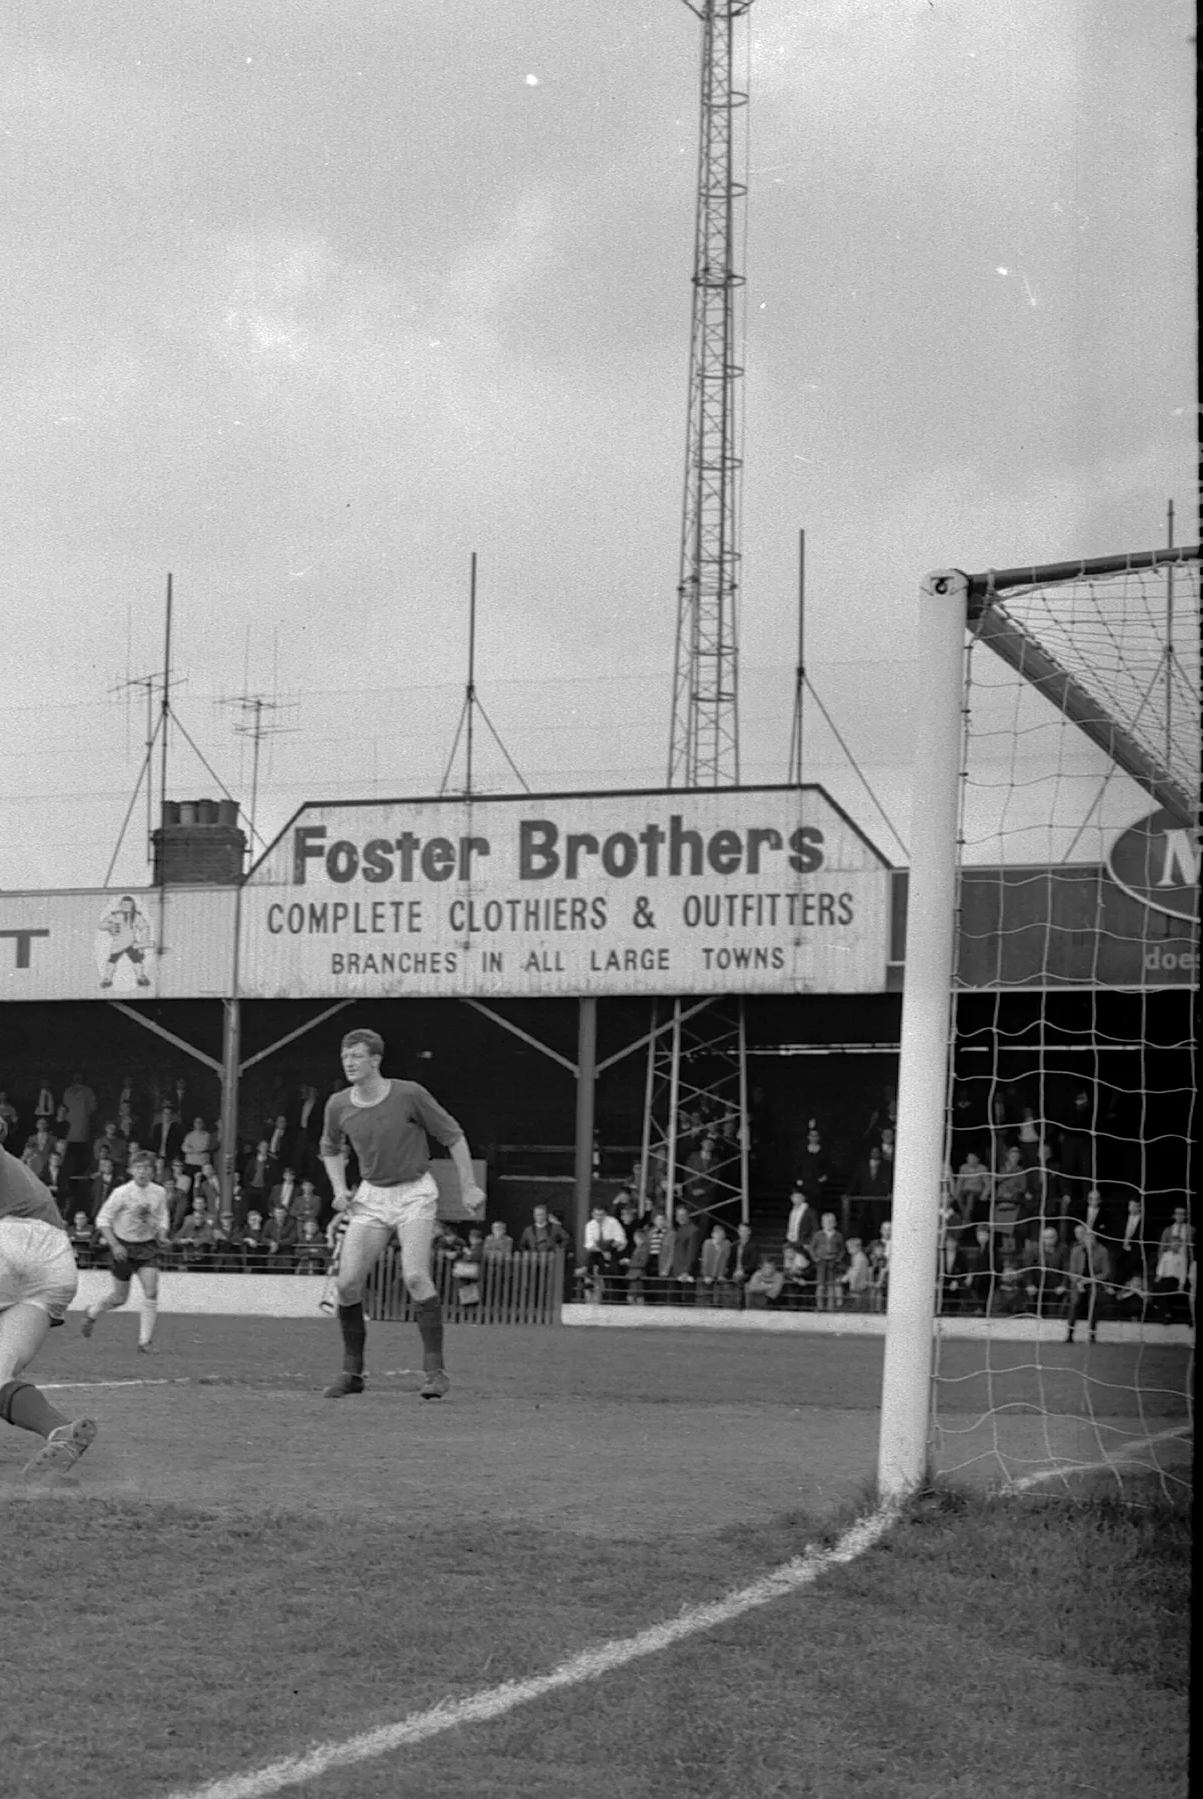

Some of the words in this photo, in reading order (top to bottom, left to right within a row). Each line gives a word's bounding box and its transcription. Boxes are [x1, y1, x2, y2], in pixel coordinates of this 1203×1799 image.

[293, 825, 491, 885] Foster
[519, 815, 825, 880] Brothers
[267, 901, 422, 934] COMPLETE
[449, 897, 607, 932] CLOTHIERS
[633, 896, 655, 928] &
[683, 893, 854, 927] OUTFITTERS
[332, 952, 457, 974] BRANCHES
[482, 952, 503, 972] IN
[525, 950, 565, 972] ALL
[591, 949, 670, 971] LARGE
[702, 947, 785, 970] TOWNS
[1146, 946, 1200, 970] doe
